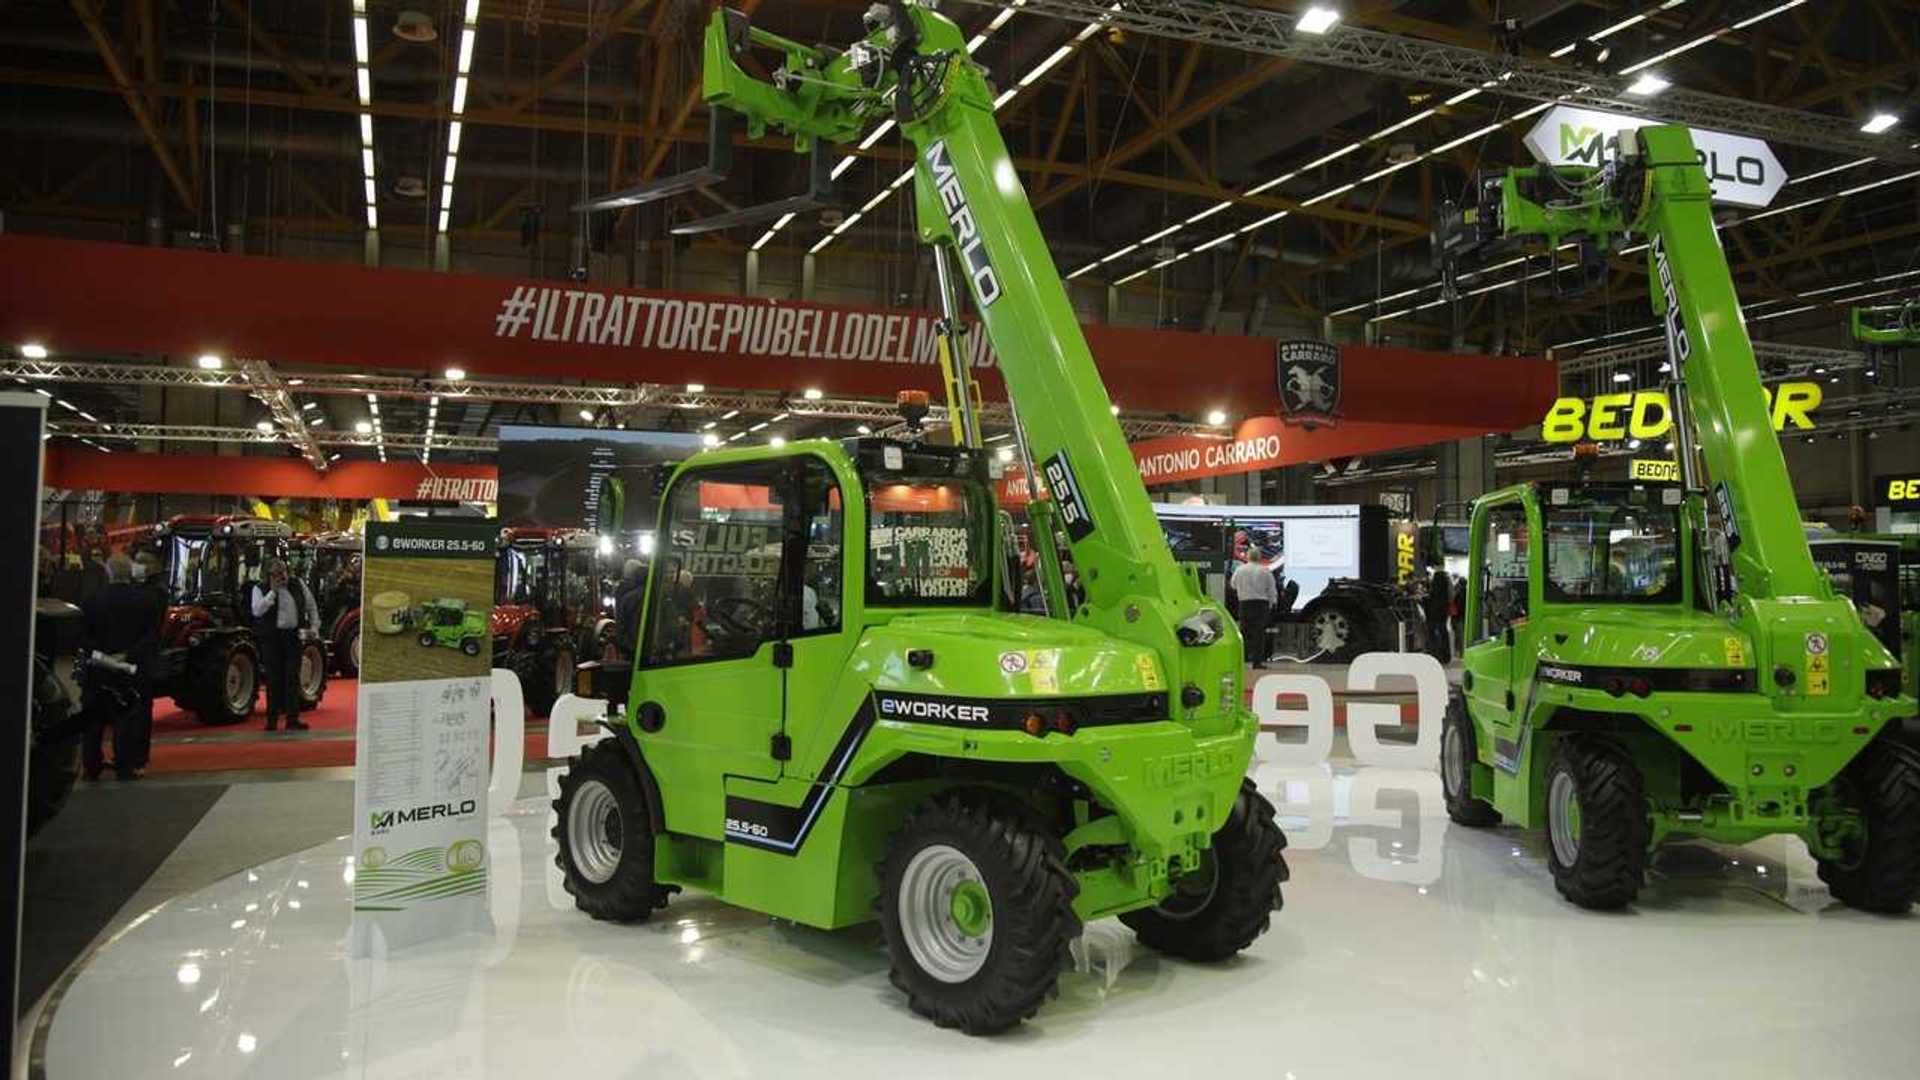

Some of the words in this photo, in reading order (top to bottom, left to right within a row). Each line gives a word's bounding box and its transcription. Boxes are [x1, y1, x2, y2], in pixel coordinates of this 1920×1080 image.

[926, 138, 1001, 306] MERLO
[1651, 232, 1690, 361] MERLO
[1542, 382, 1823, 443] BEDR
[1139, 450, 1200, 477] ANTONIO
[1205, 435, 1280, 468] CARRARO
[1045, 462, 1080, 524] 25.5
[446, 540, 485, 551] 25.5-60
[881, 698, 990, 723] eWORKER
[1711, 720, 1843, 745] MERLO
[1142, 751, 1235, 787] MERLO
[398, 800, 476, 824] MERLO
